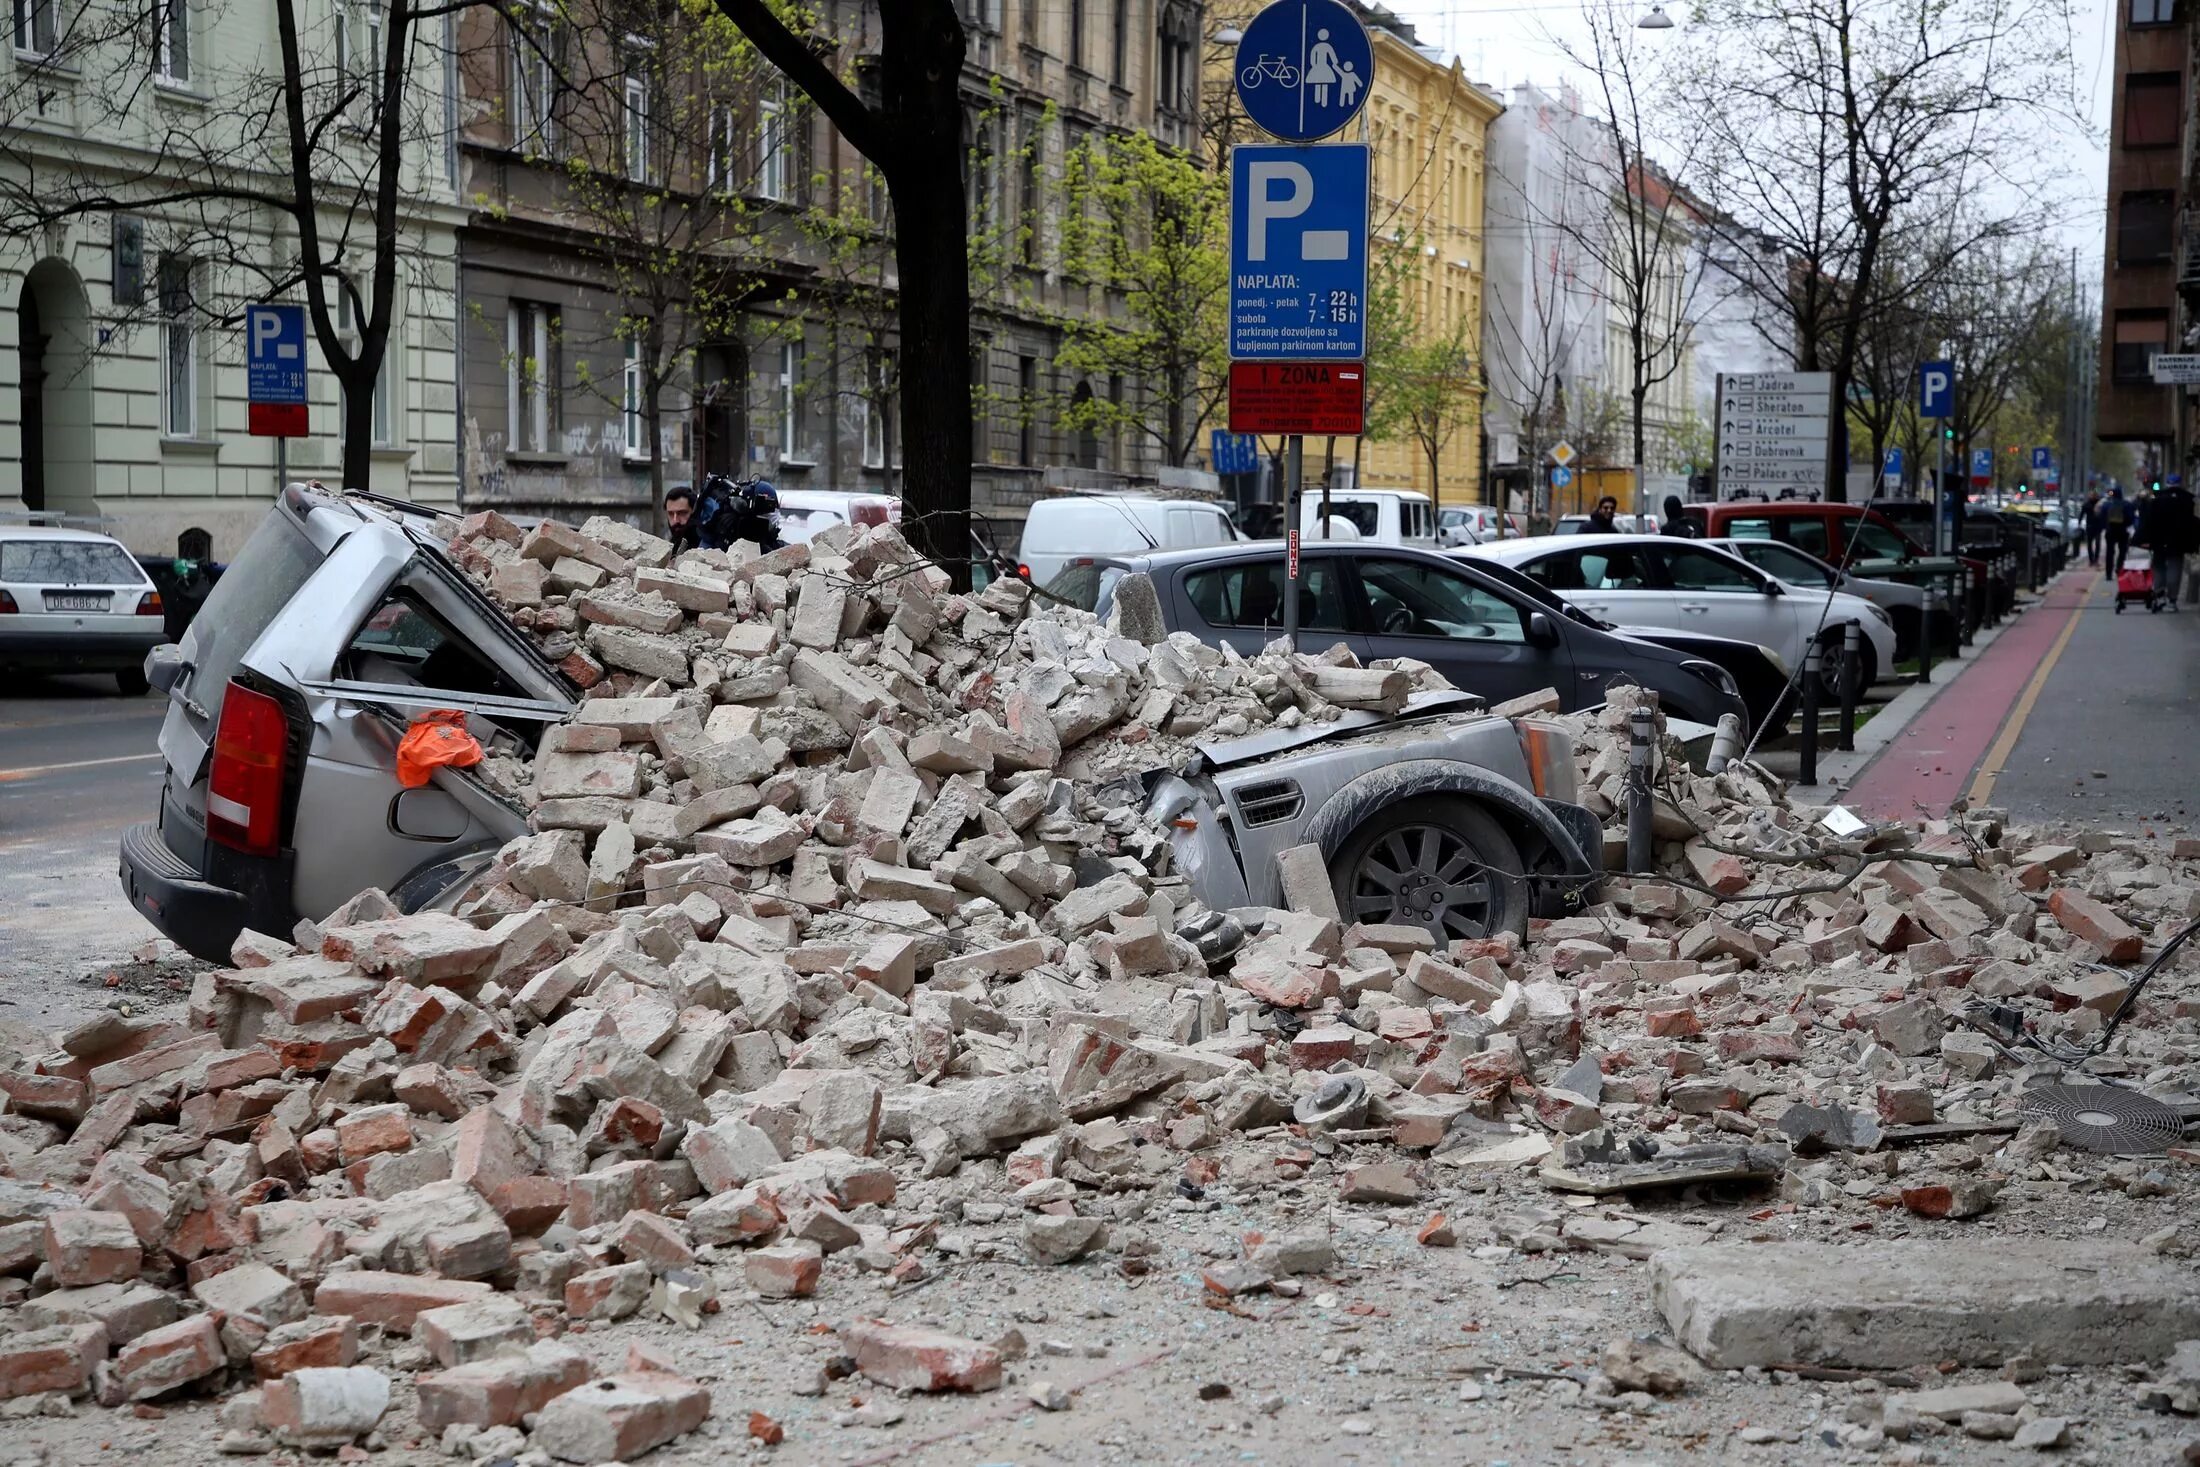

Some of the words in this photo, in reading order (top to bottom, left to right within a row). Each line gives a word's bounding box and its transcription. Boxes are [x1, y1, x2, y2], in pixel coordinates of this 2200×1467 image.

[1247, 161, 1314, 261] P
[1237, 275, 1300, 289] NAPLATA:
[1237, 298, 1268, 309] ponedj.
[1276, 298, 1300, 309] petak
[1308, 293, 1317, 306] 7
[1330, 291, 1347, 306] 22
[1350, 293, 1357, 306] h
[1237, 314, 1266, 324] subota
[1308, 310, 1317, 323] 7
[1331, 308, 1347, 322] 15
[1349, 310, 1357, 323] h
[253, 311, 282, 358] P
[1236, 327, 1279, 338] parkiranje
[1281, 327, 1326, 338] dozvoljeno
[1327, 328, 1338, 337] sa
[1236, 341, 1279, 352] kupljenom
[1281, 341, 1324, 352] parkirnom
[1326, 341, 1356, 351] kartom
[1280, 367, 1331, 384] ZONA
[1758, 381, 1795, 390] Jadran
[1925, 372, 1948, 407] P
[1756, 402, 1804, 412] Sheraton
[1756, 424, 1796, 435] Arcotel
[1755, 446, 1804, 457] Dubrovnik
[1753, 468, 1787, 478] Palace
